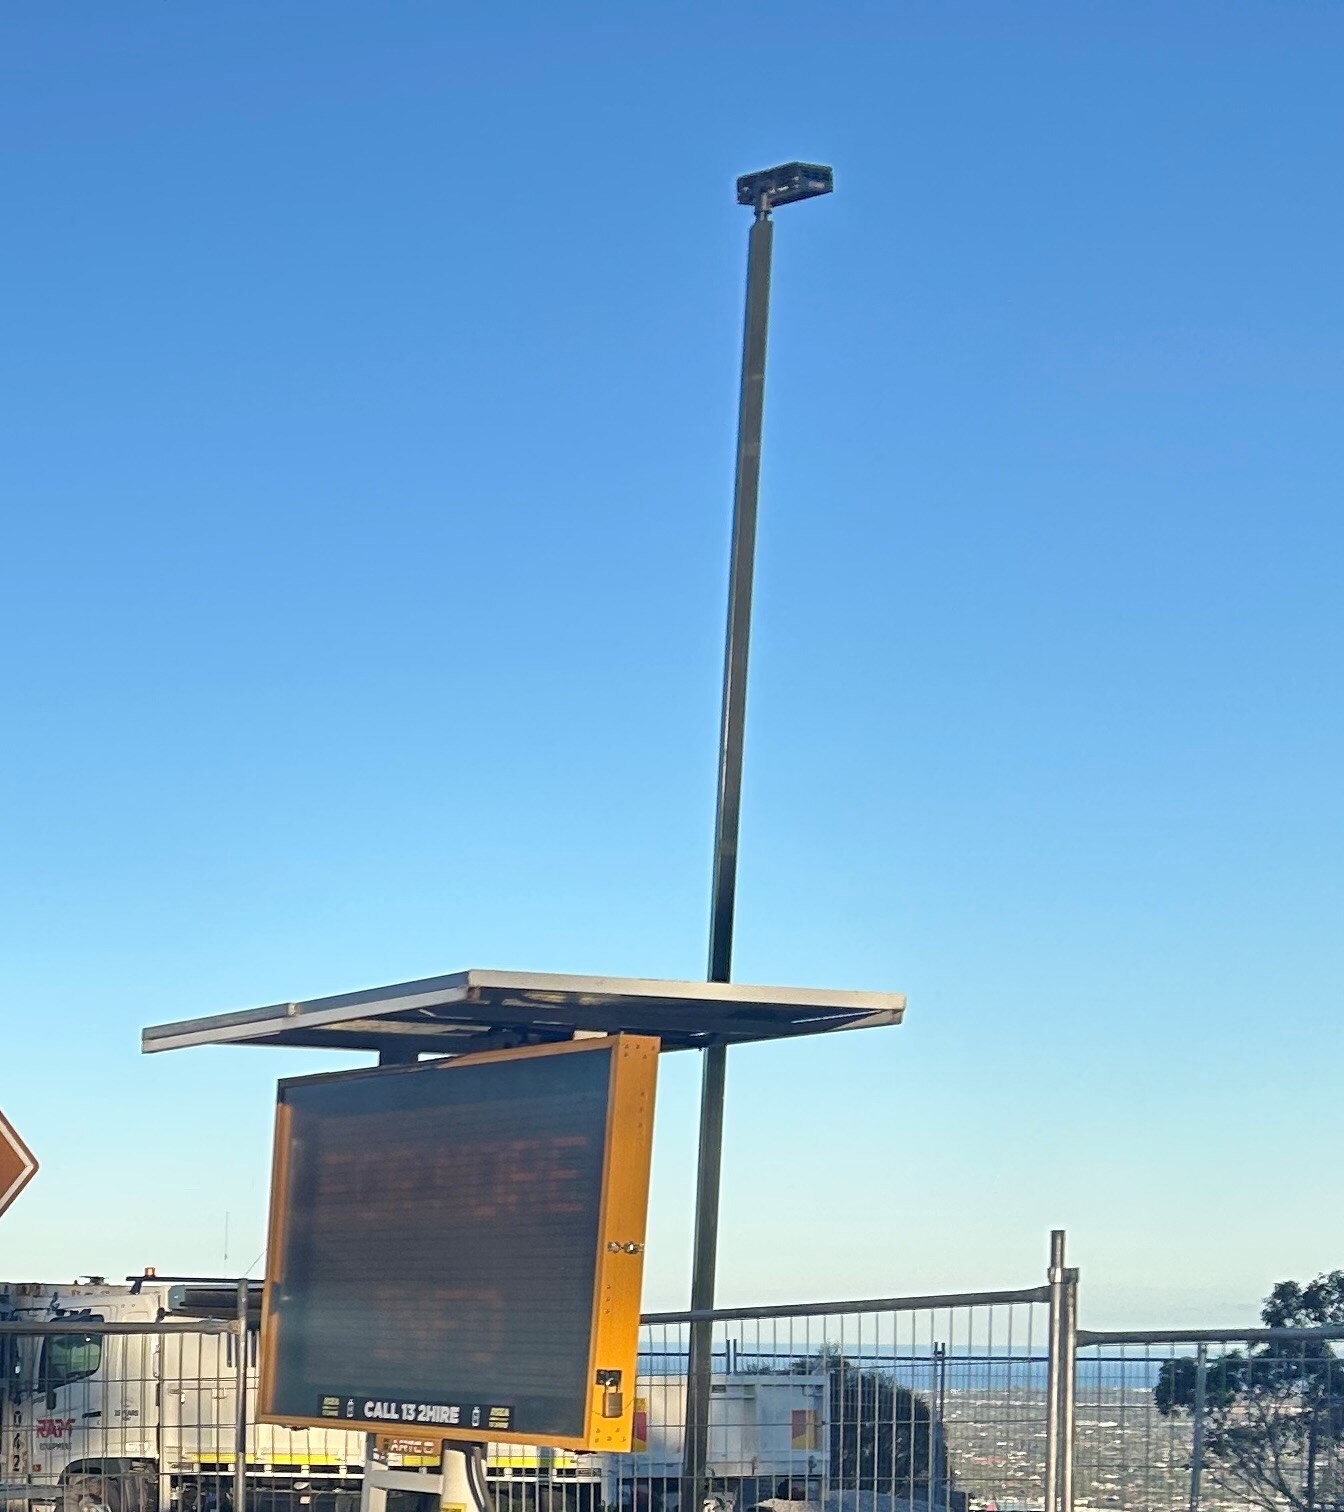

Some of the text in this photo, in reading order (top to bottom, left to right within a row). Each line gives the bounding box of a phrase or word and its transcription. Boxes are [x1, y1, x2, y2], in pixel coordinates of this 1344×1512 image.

[363, 1401, 460, 1424] CALL 13 2HIRE
